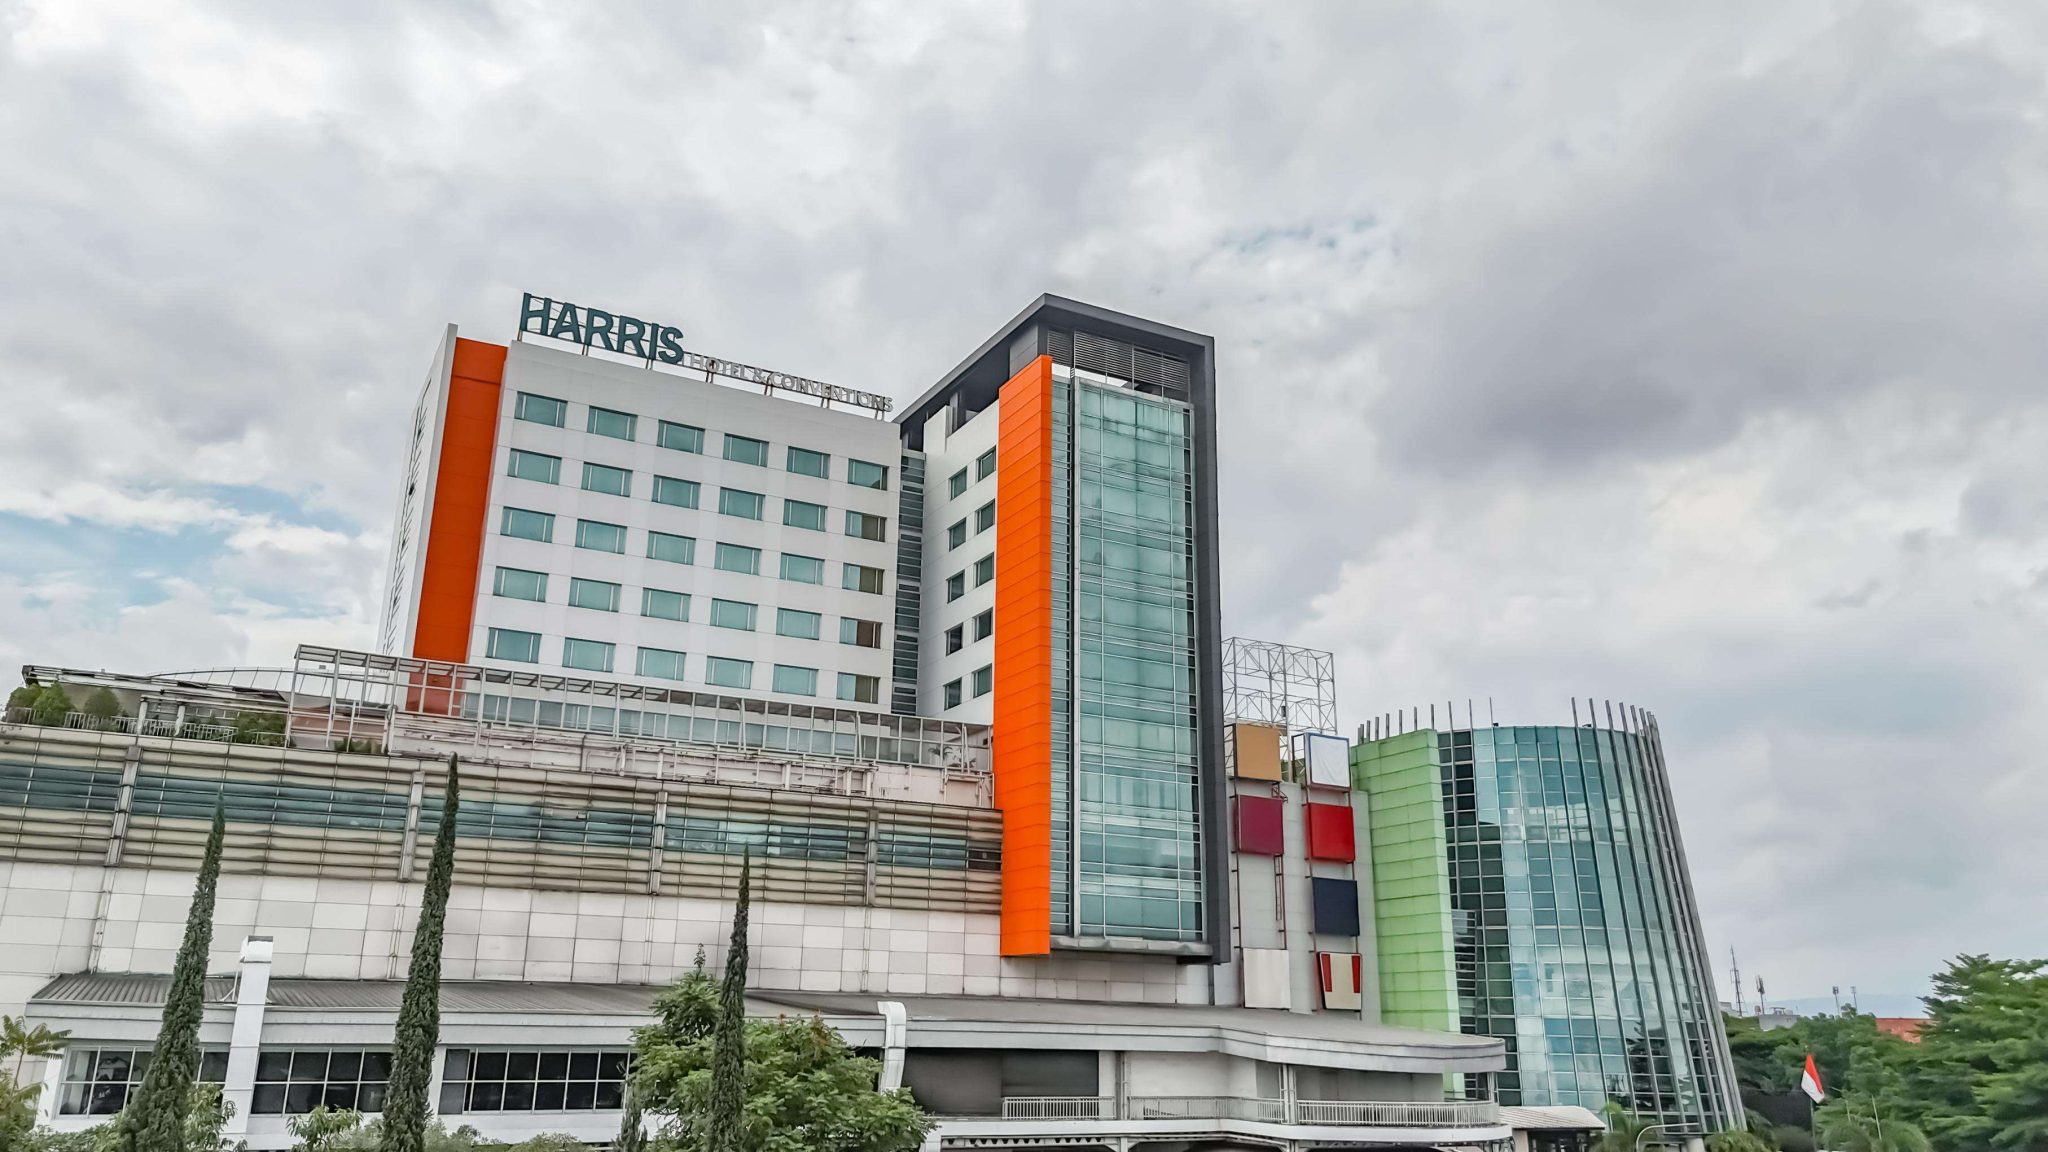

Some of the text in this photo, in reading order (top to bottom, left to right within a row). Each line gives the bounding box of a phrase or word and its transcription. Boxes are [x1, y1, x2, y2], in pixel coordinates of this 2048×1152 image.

[520, 292, 893, 412] HARRIS HOTEL & CONVENTIONS
